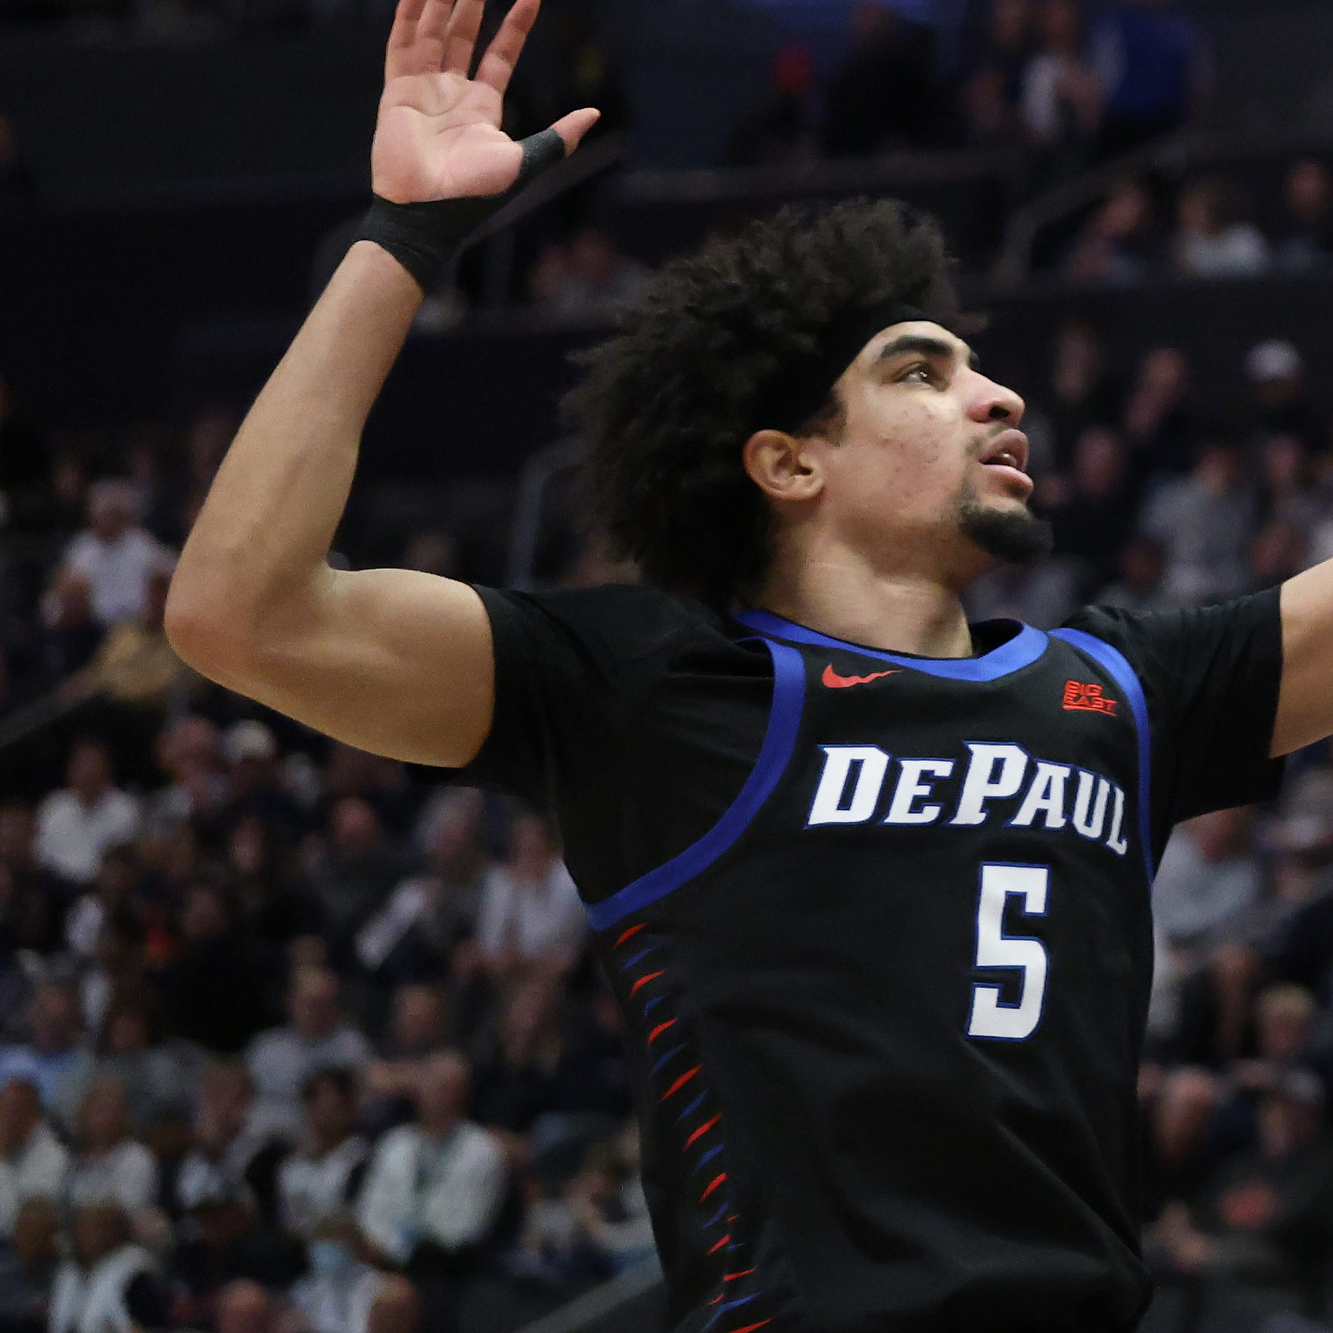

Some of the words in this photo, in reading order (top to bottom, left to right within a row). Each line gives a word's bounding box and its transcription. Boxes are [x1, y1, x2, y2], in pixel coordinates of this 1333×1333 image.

[1064, 679, 1104, 697] BIG
[1063, 693, 1118, 712] EAST
[966, 861, 1050, 1043] 5
